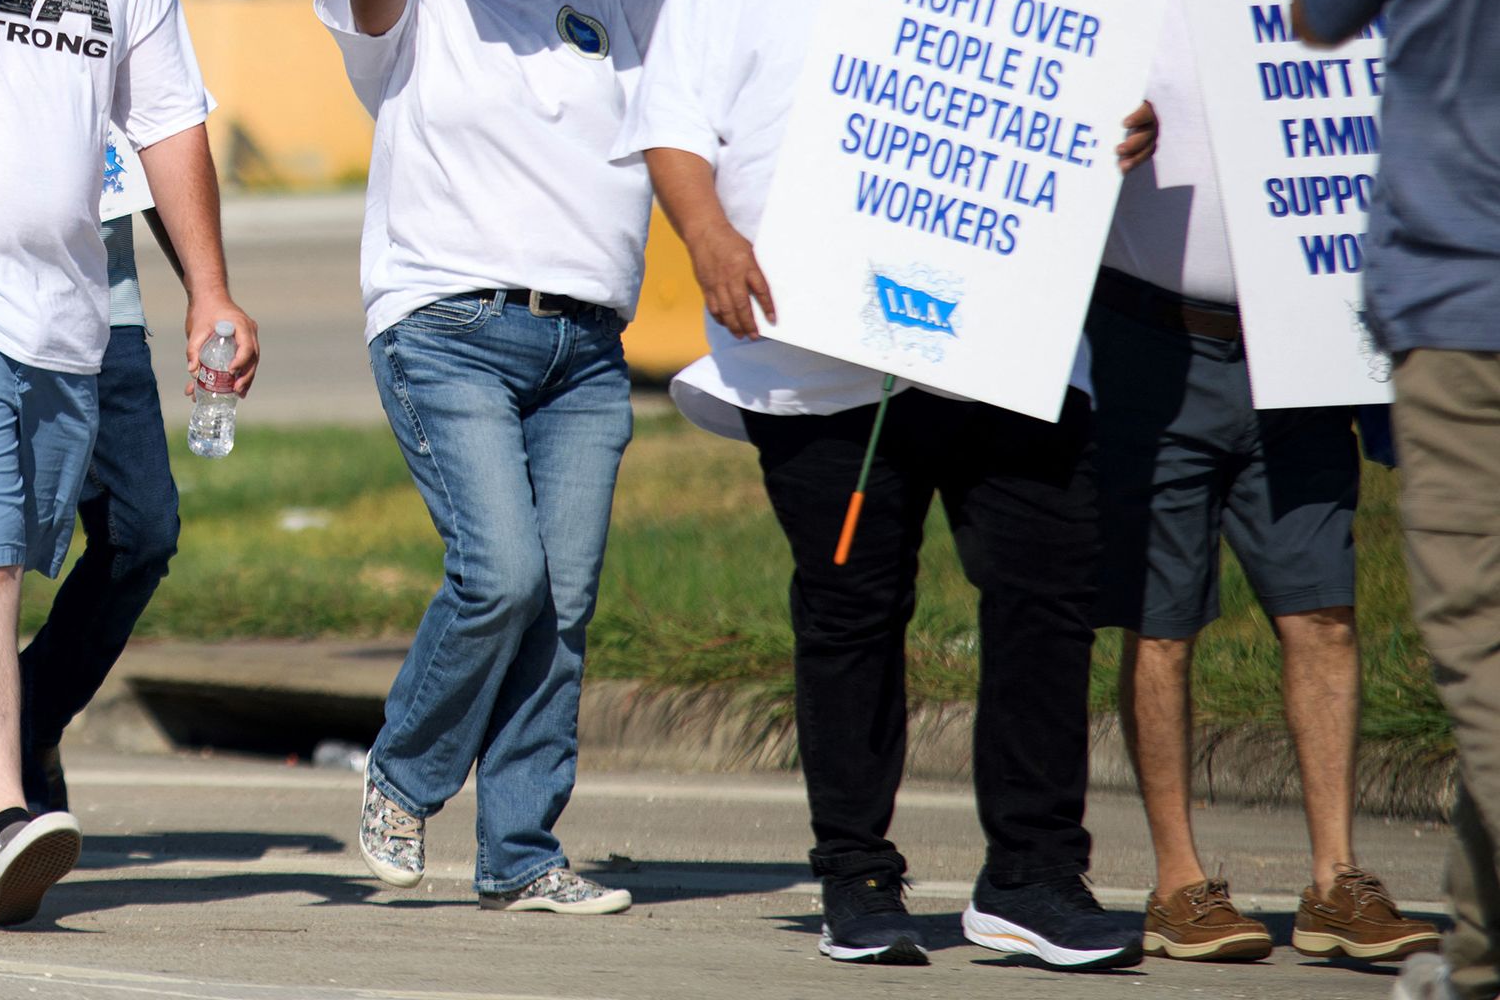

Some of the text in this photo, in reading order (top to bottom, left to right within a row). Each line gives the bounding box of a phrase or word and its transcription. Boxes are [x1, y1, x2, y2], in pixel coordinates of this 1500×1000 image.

[893, 17, 1064, 101] PEOPLE IS
[1256, 58, 1352, 101] DON'T
[841, 112, 1058, 214] SUPPORT ILA
[1264, 174, 1375, 218] SUPPO
[854, 171, 1021, 256] WORKERS
